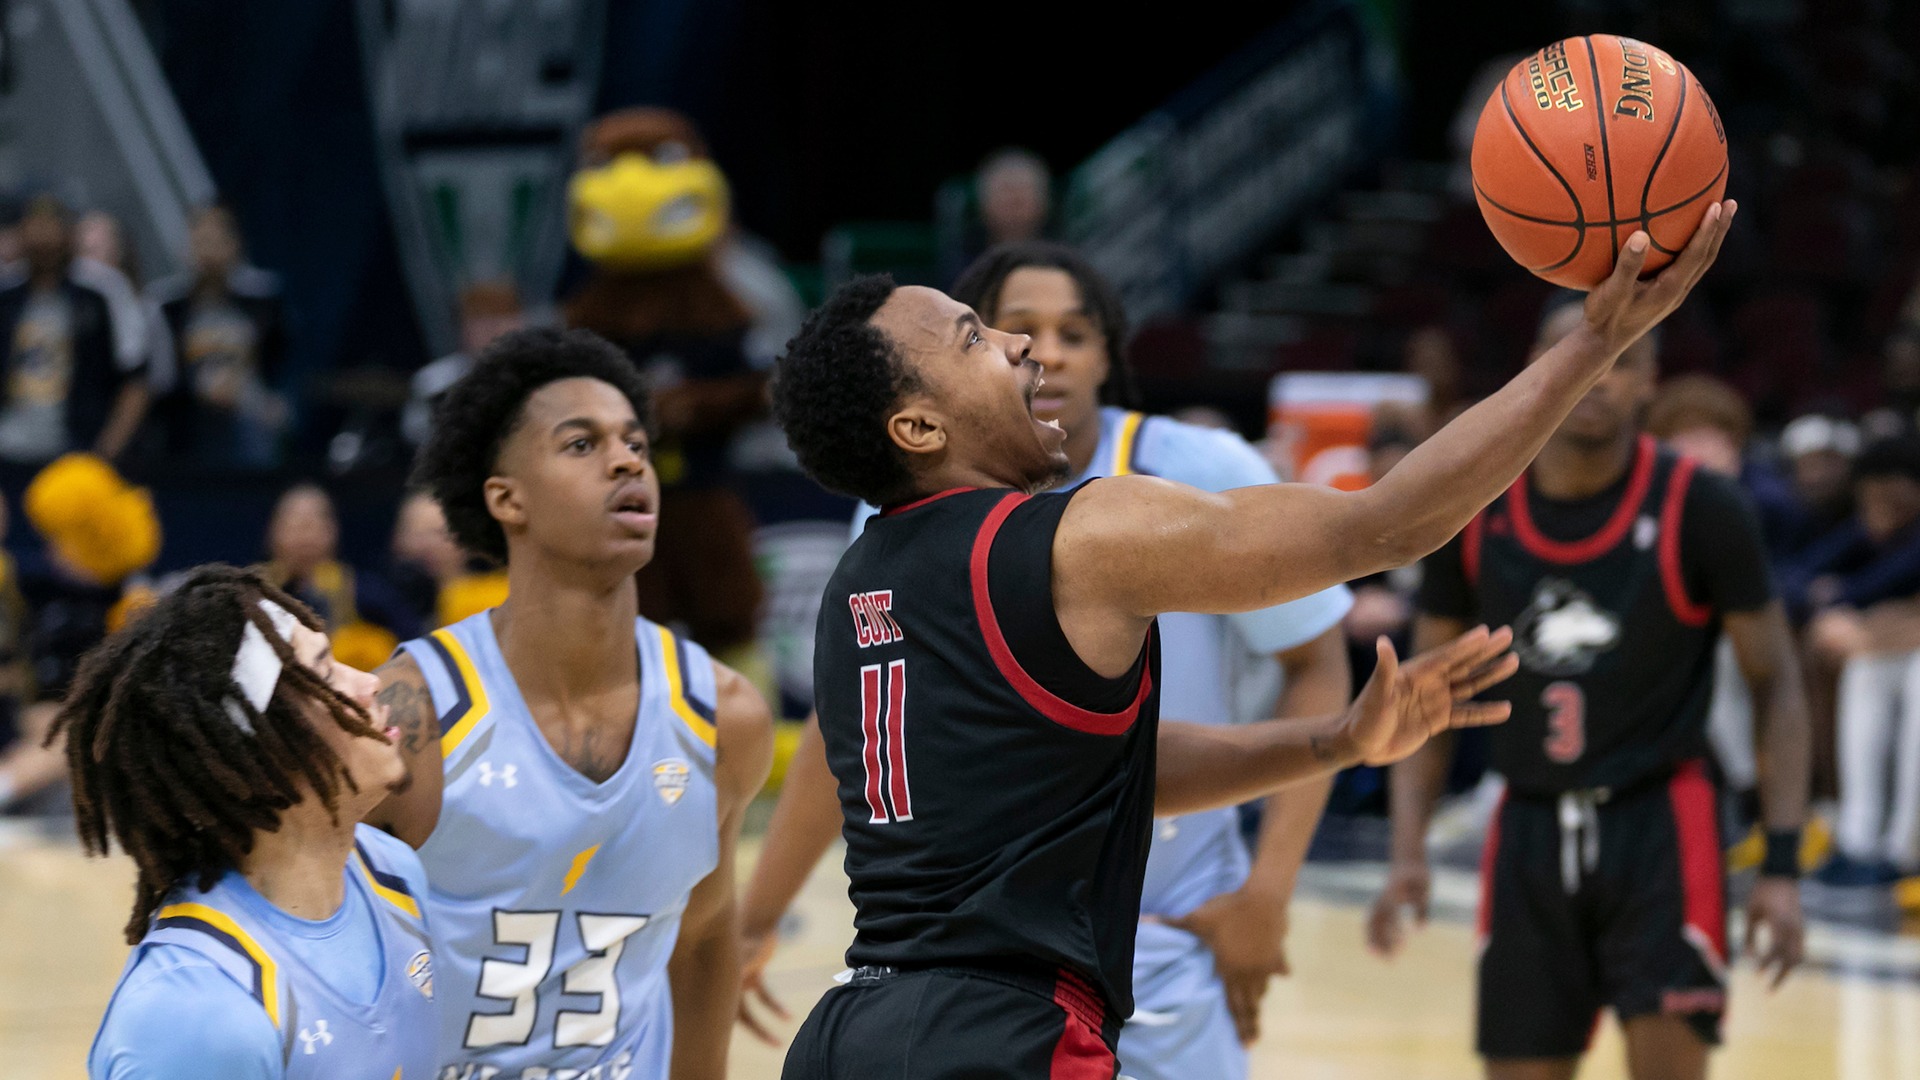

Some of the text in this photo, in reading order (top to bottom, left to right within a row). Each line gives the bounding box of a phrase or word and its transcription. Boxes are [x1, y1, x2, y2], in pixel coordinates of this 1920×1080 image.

[849, 589, 904, 648] COIT
[860, 658, 914, 824] 11
[1541, 680, 1587, 764] 3
[462, 907, 651, 1050] 33
